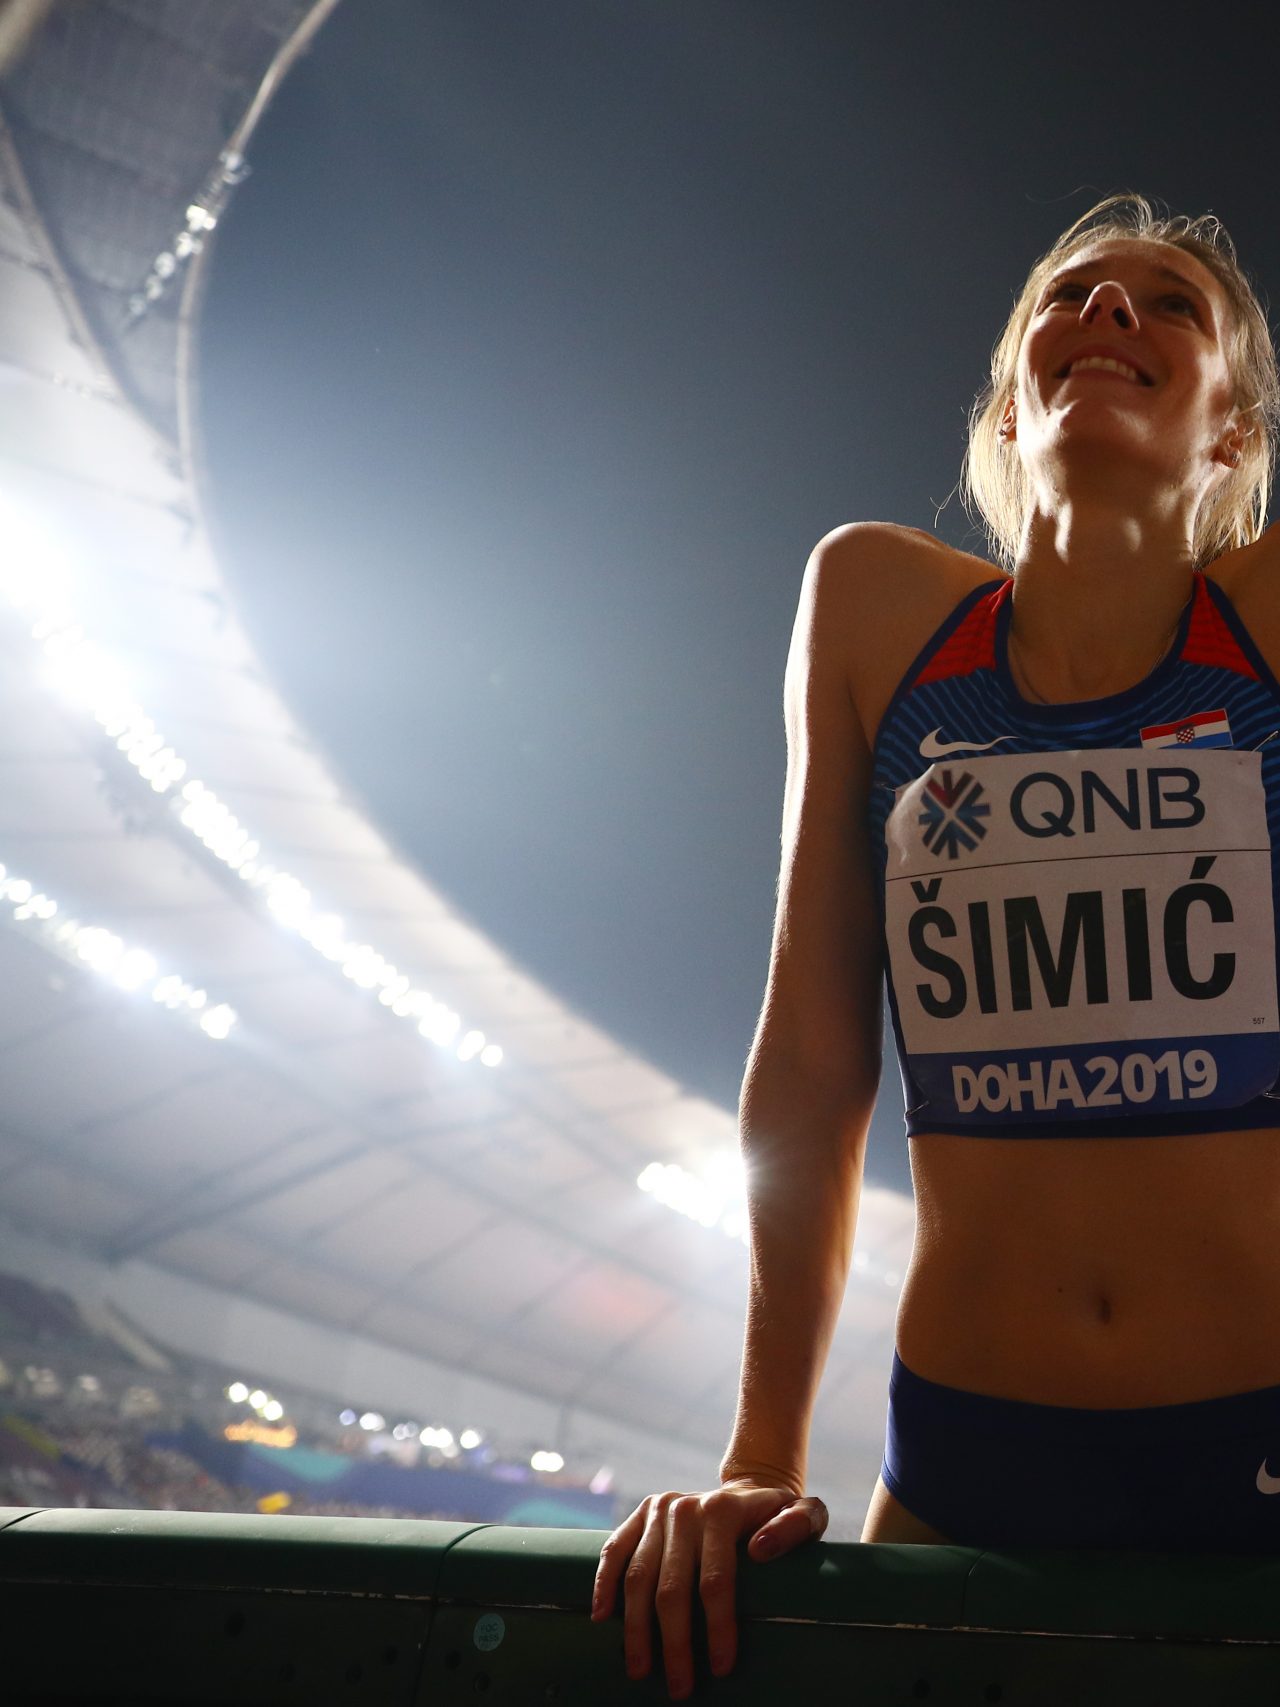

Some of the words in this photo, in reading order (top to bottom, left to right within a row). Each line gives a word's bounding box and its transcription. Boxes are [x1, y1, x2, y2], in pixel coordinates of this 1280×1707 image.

[1010, 767, 1206, 839] QNB
[907, 855, 1237, 1019] ŠIMIĆ
[951, 1049, 1218, 1113] DOHA2019
